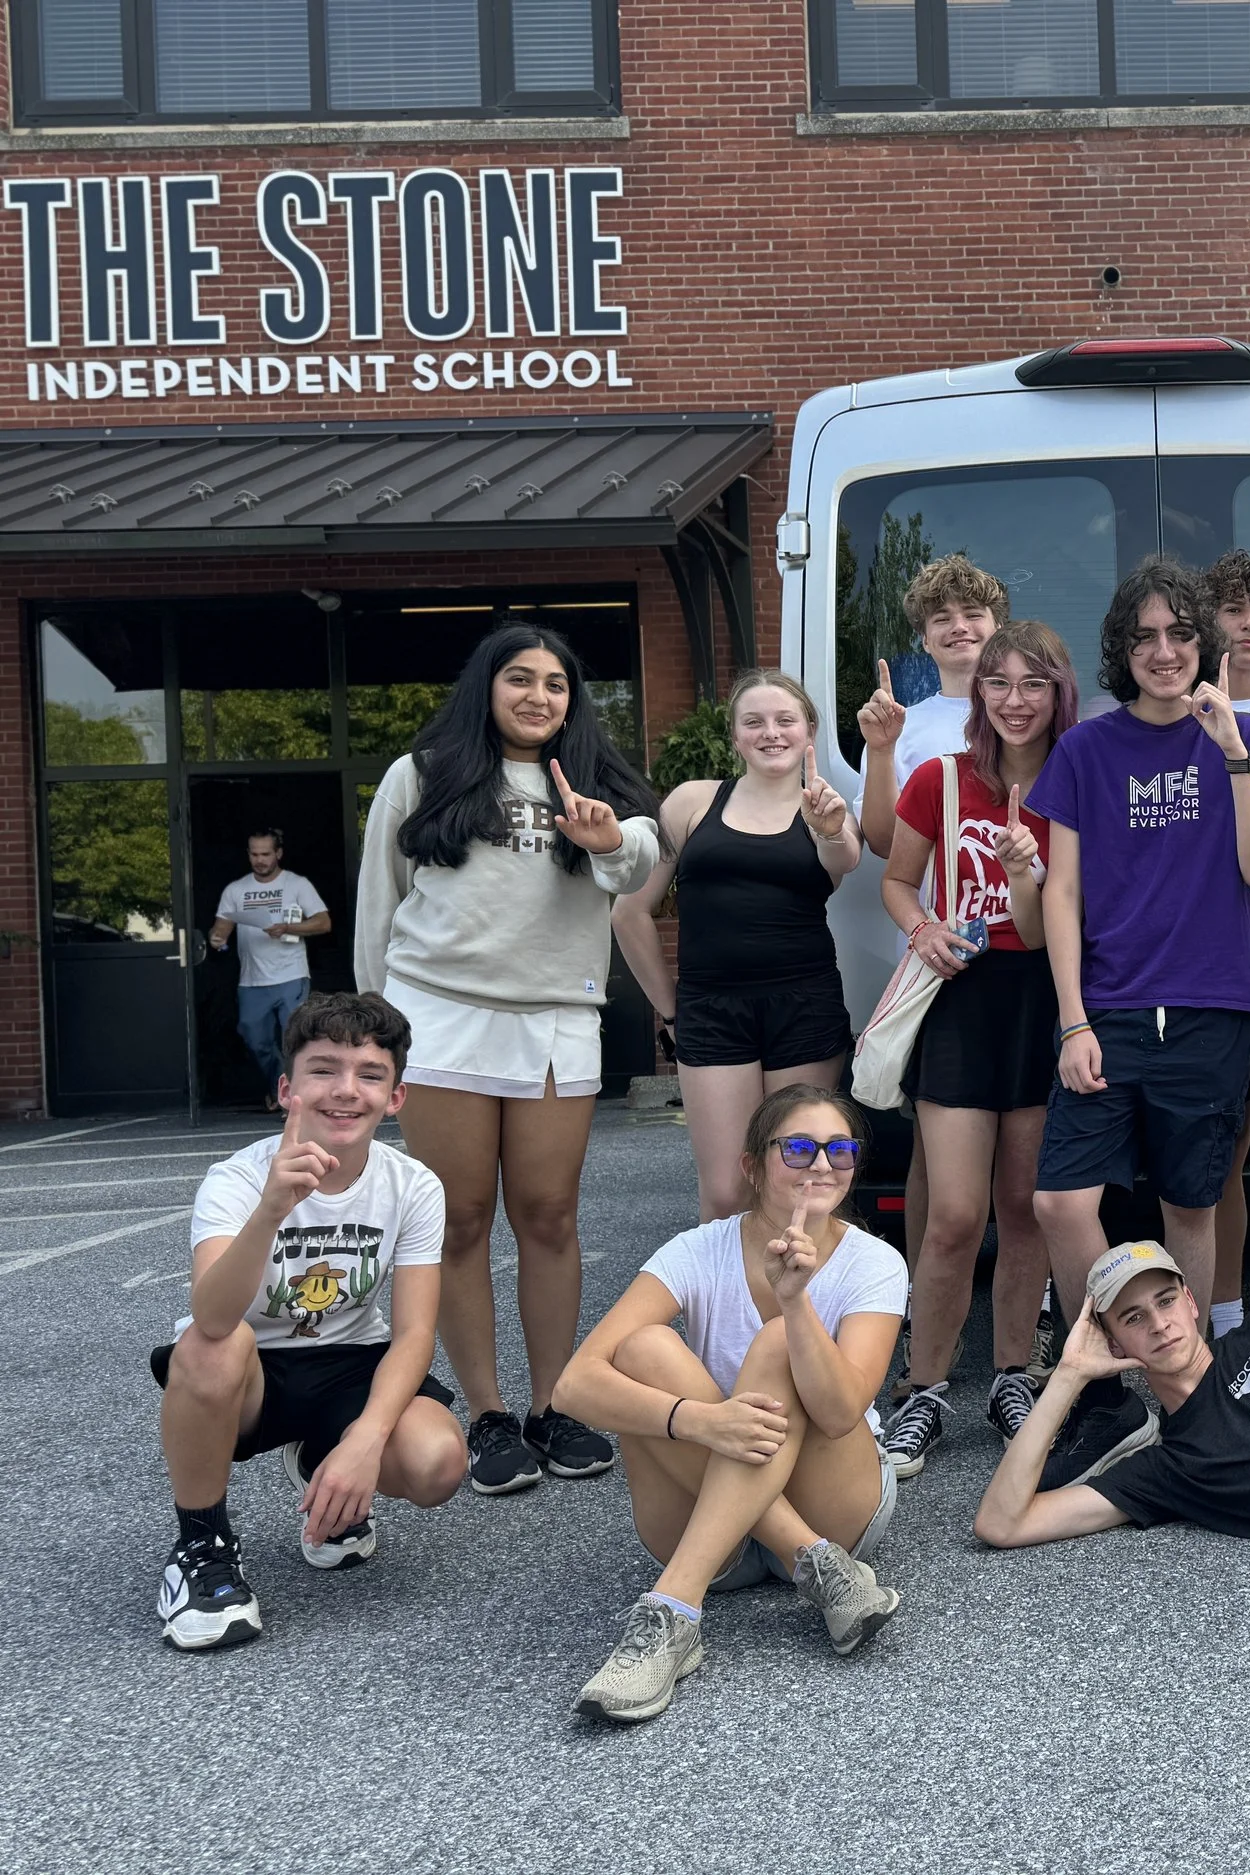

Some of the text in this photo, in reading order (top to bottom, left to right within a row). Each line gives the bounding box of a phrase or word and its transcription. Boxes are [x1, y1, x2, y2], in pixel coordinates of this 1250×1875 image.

[3, 167, 628, 348] THE STONE
[26, 349, 633, 401] INDEPENDENT SCHOOL
[1129, 765, 1200, 804] MFE
[1129, 798, 1200, 817] MUSIC FOR
[1129, 809, 1200, 828] EVERYONE
[243, 888, 284, 901] STONE
[1100, 1252, 1132, 1279] Rotary
